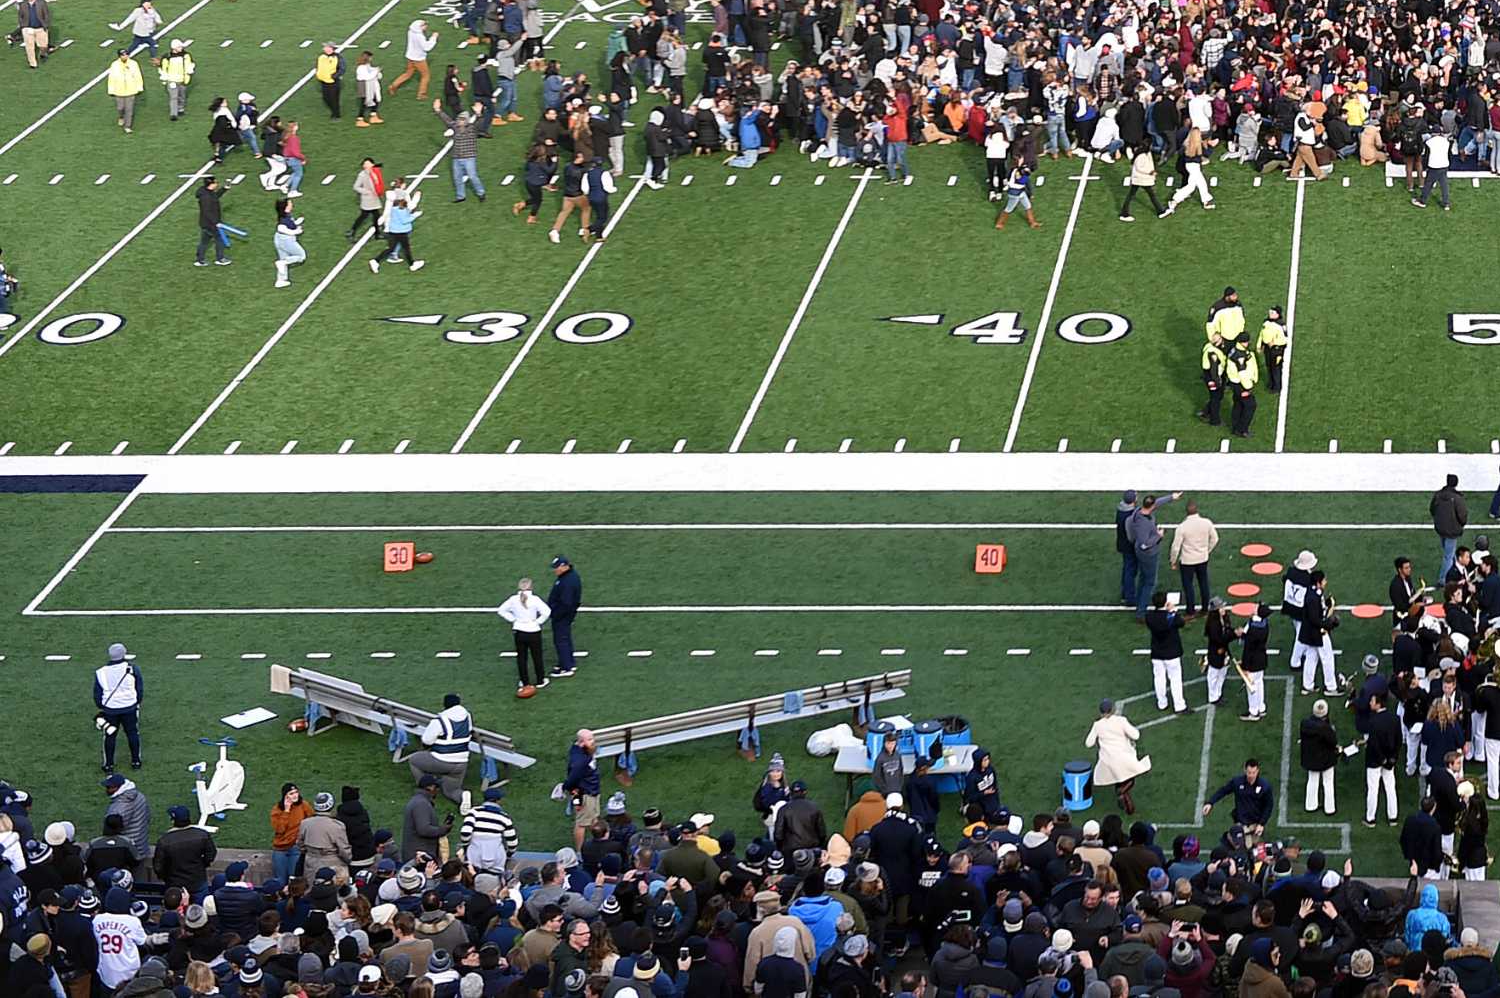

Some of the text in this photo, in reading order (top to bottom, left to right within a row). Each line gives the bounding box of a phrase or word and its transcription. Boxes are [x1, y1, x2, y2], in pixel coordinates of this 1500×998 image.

[444, 310, 634, 346] 30
[950, 311, 1133, 345] 40
[389, 547, 408, 564] 30
[981, 549, 999, 566] 40
[95, 921, 132, 936] CARPENTER
[100, 933, 122, 954] 29
